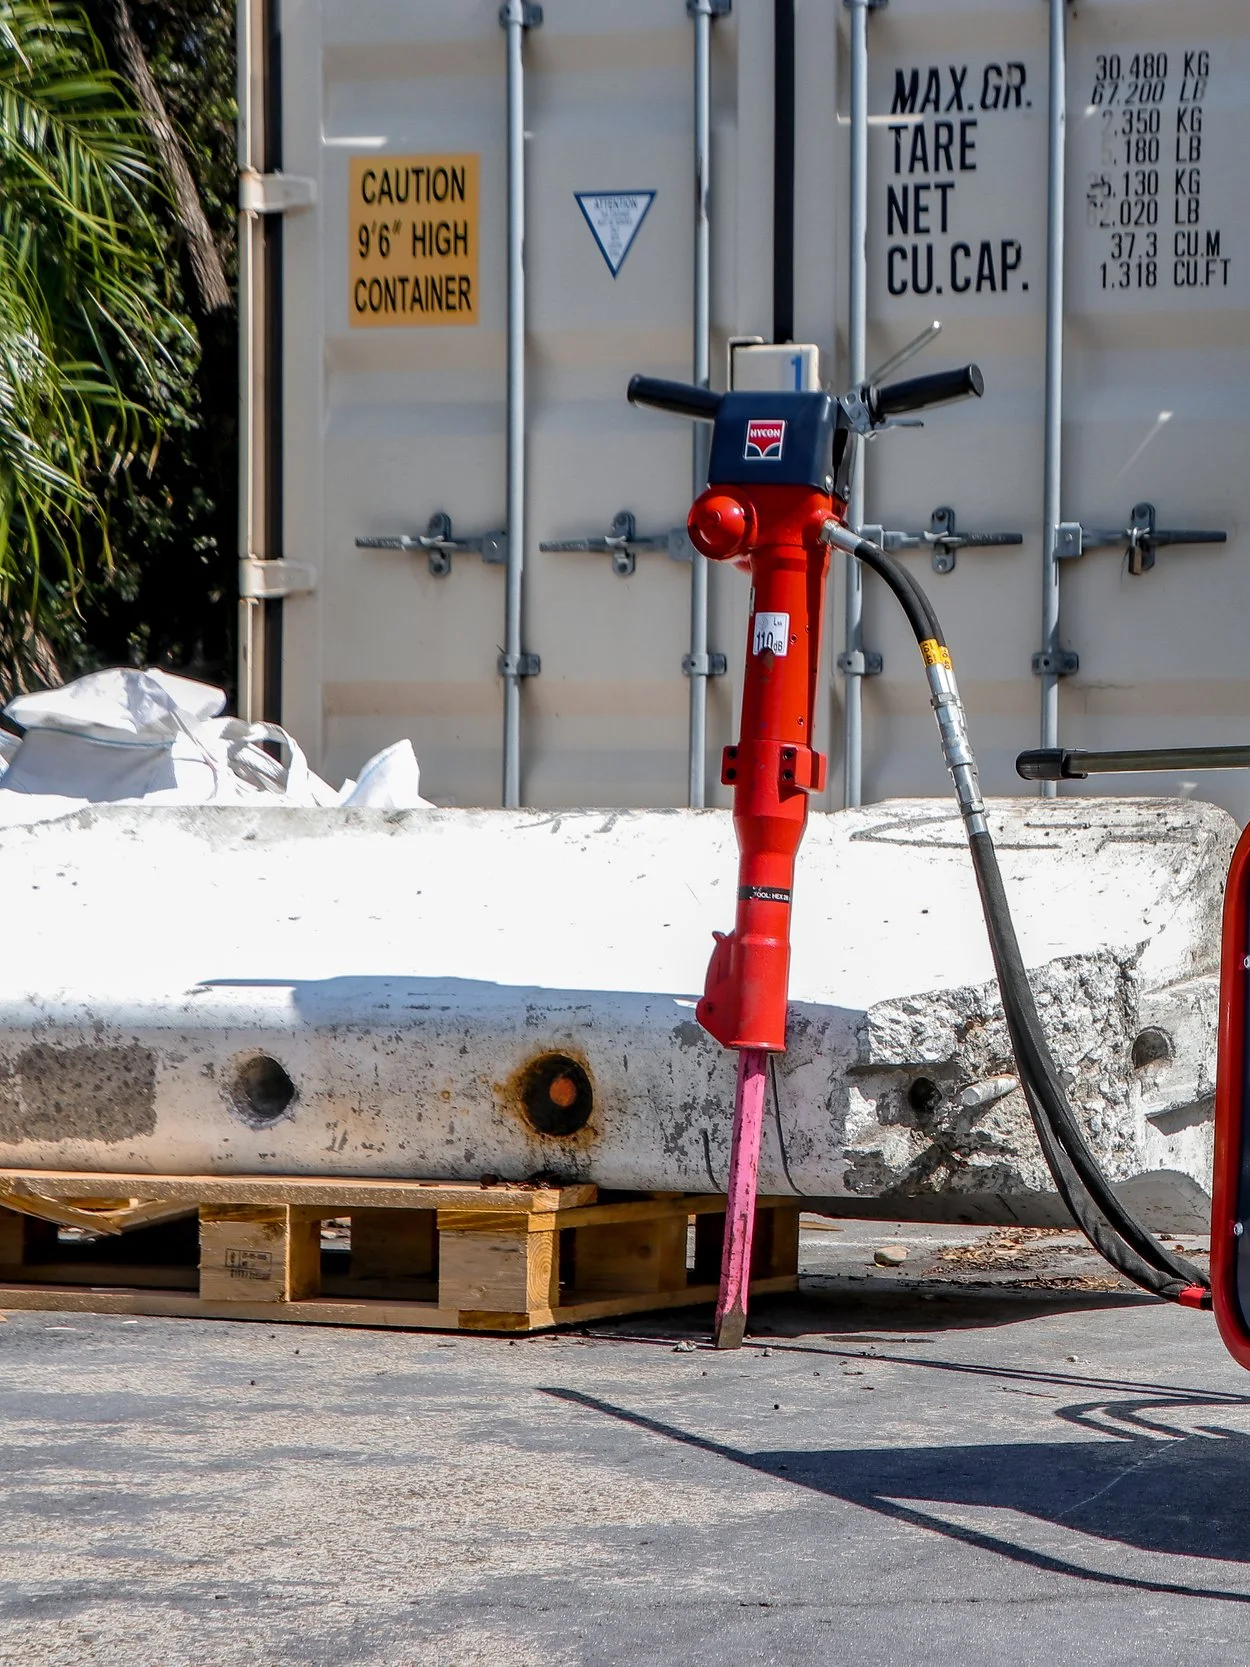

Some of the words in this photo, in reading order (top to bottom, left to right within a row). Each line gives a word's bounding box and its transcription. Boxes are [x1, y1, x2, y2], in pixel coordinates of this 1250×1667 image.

[1183, 50, 1209, 78] KG
[890, 62, 1033, 115] MAX.GR.
[1179, 78, 1207, 103] LB
[1176, 106, 1202, 133] KG
[888, 118, 978, 174] TARE
[1175, 134, 1201, 163] LB
[361, 165, 466, 206] CAUTION
[1175, 167, 1200, 196] KG
[887, 181, 955, 236] NET
[1174, 197, 1200, 224] LB
[412, 220, 468, 257] HIGH
[1174, 229, 1220, 258] CU.M
[886, 239, 1030, 296] CU.CAP.
[1173, 258, 1231, 287] CU.FT
[353, 274, 473, 314] CONTAINER
[750, 428, 781, 438] HYCON
[756, 631, 774, 651] 110
